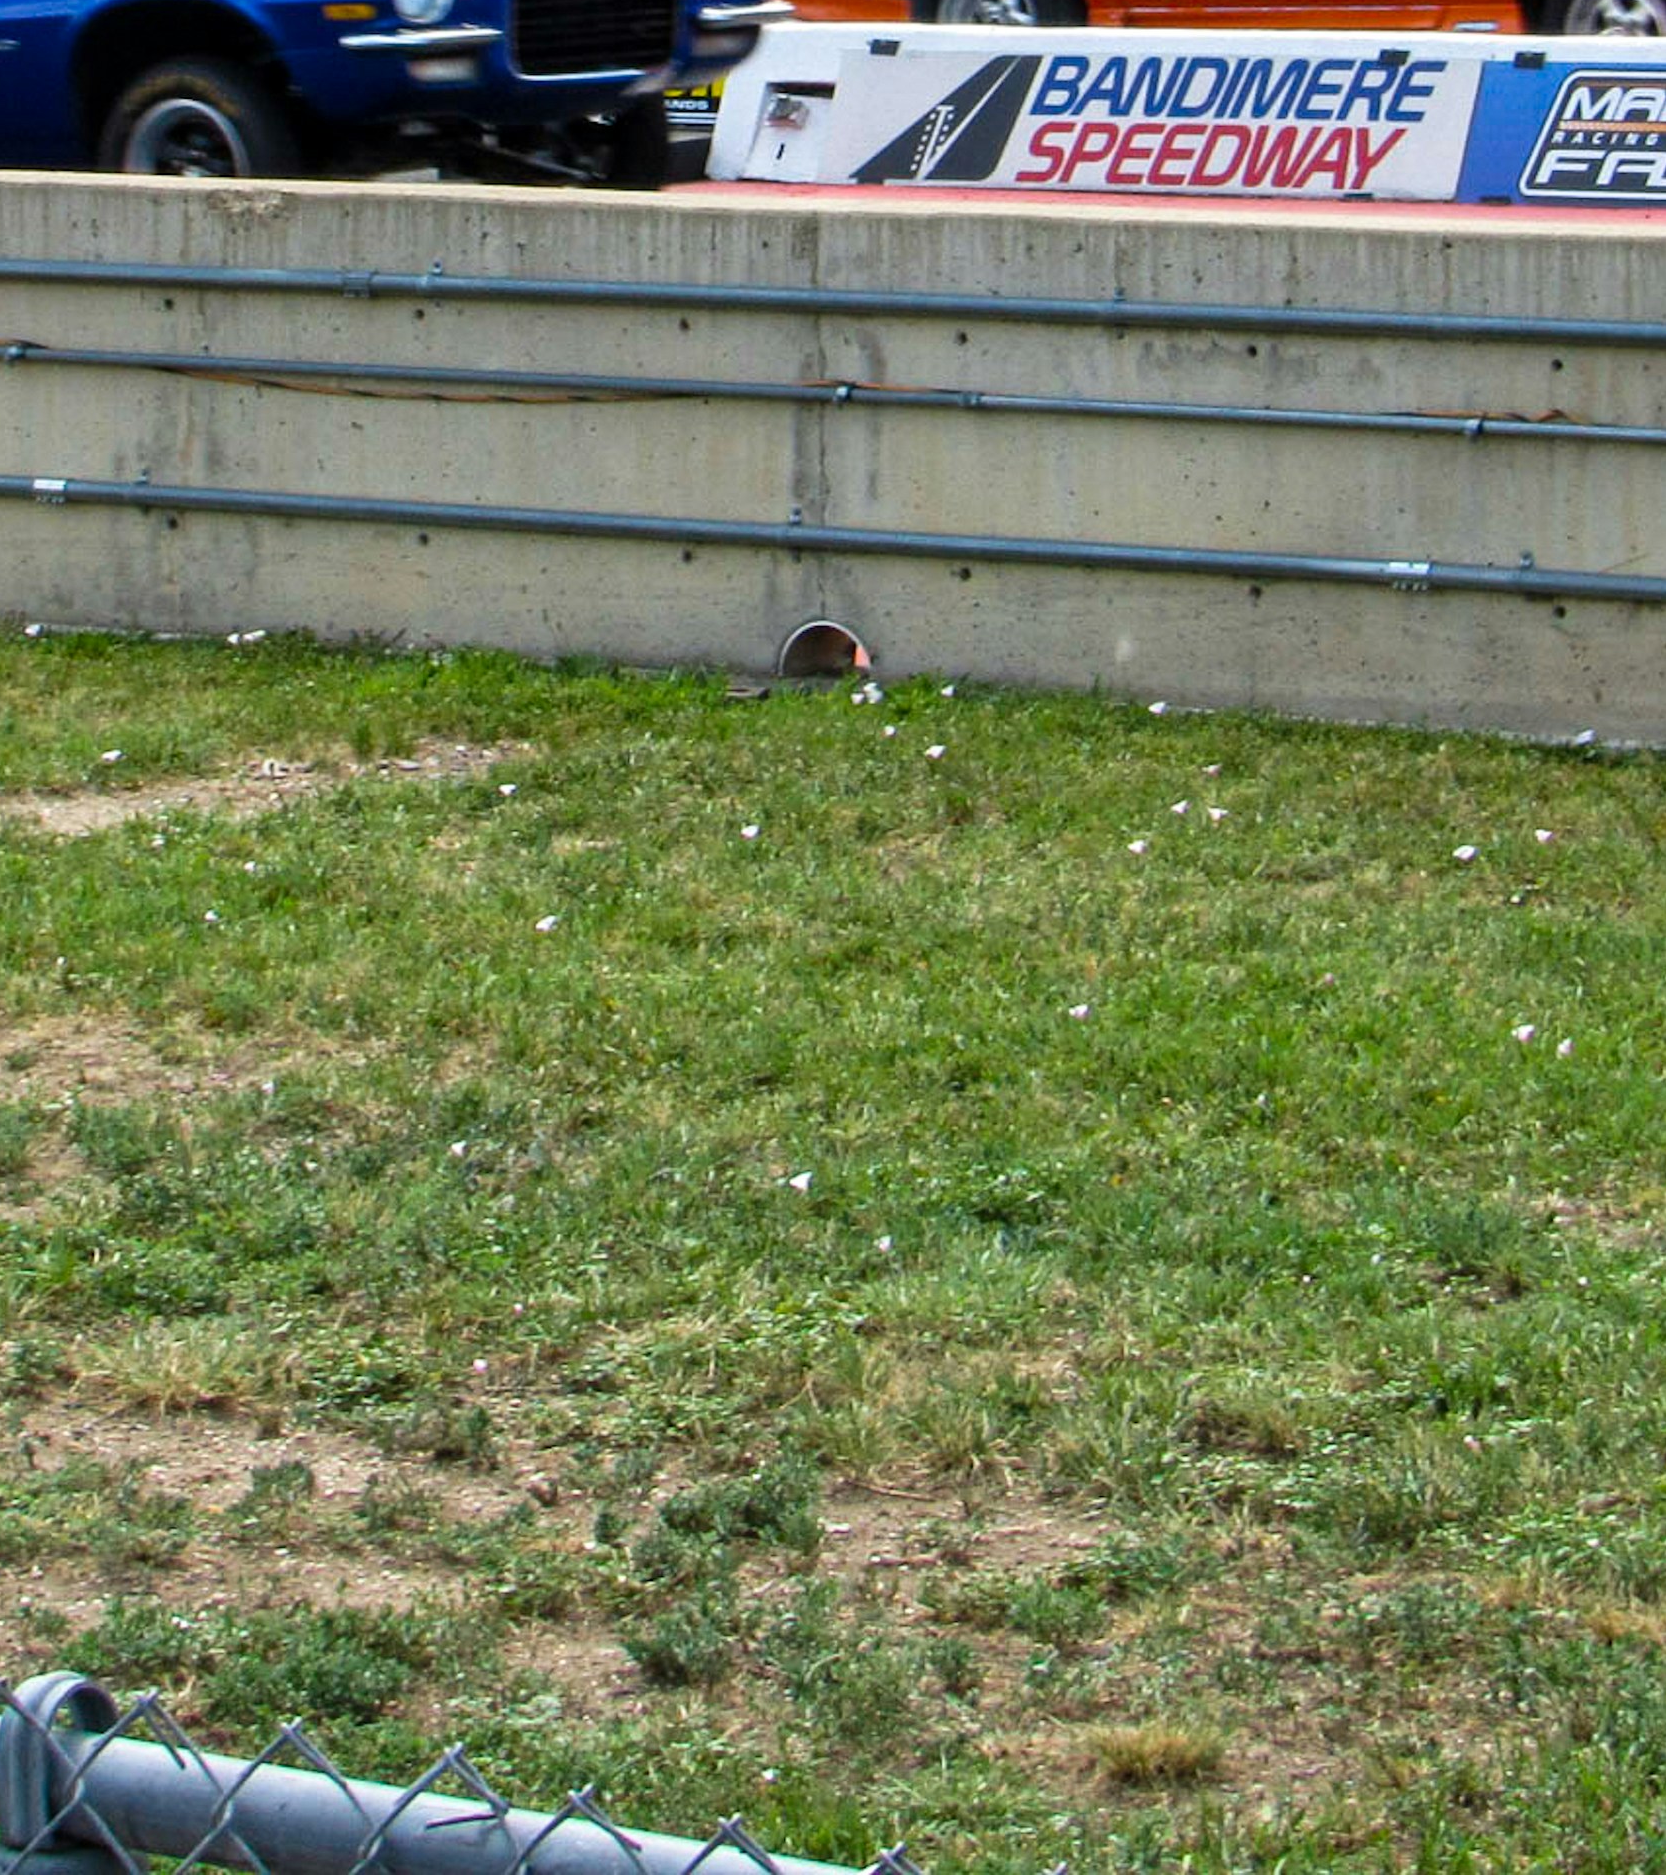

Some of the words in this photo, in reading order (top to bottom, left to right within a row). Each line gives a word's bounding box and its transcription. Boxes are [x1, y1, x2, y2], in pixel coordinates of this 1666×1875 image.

[1033, 55, 1447, 121] BANDIMERE
[1015, 122, 1407, 189] SPEEDWAY
[1552, 132, 1659, 146] RACING
